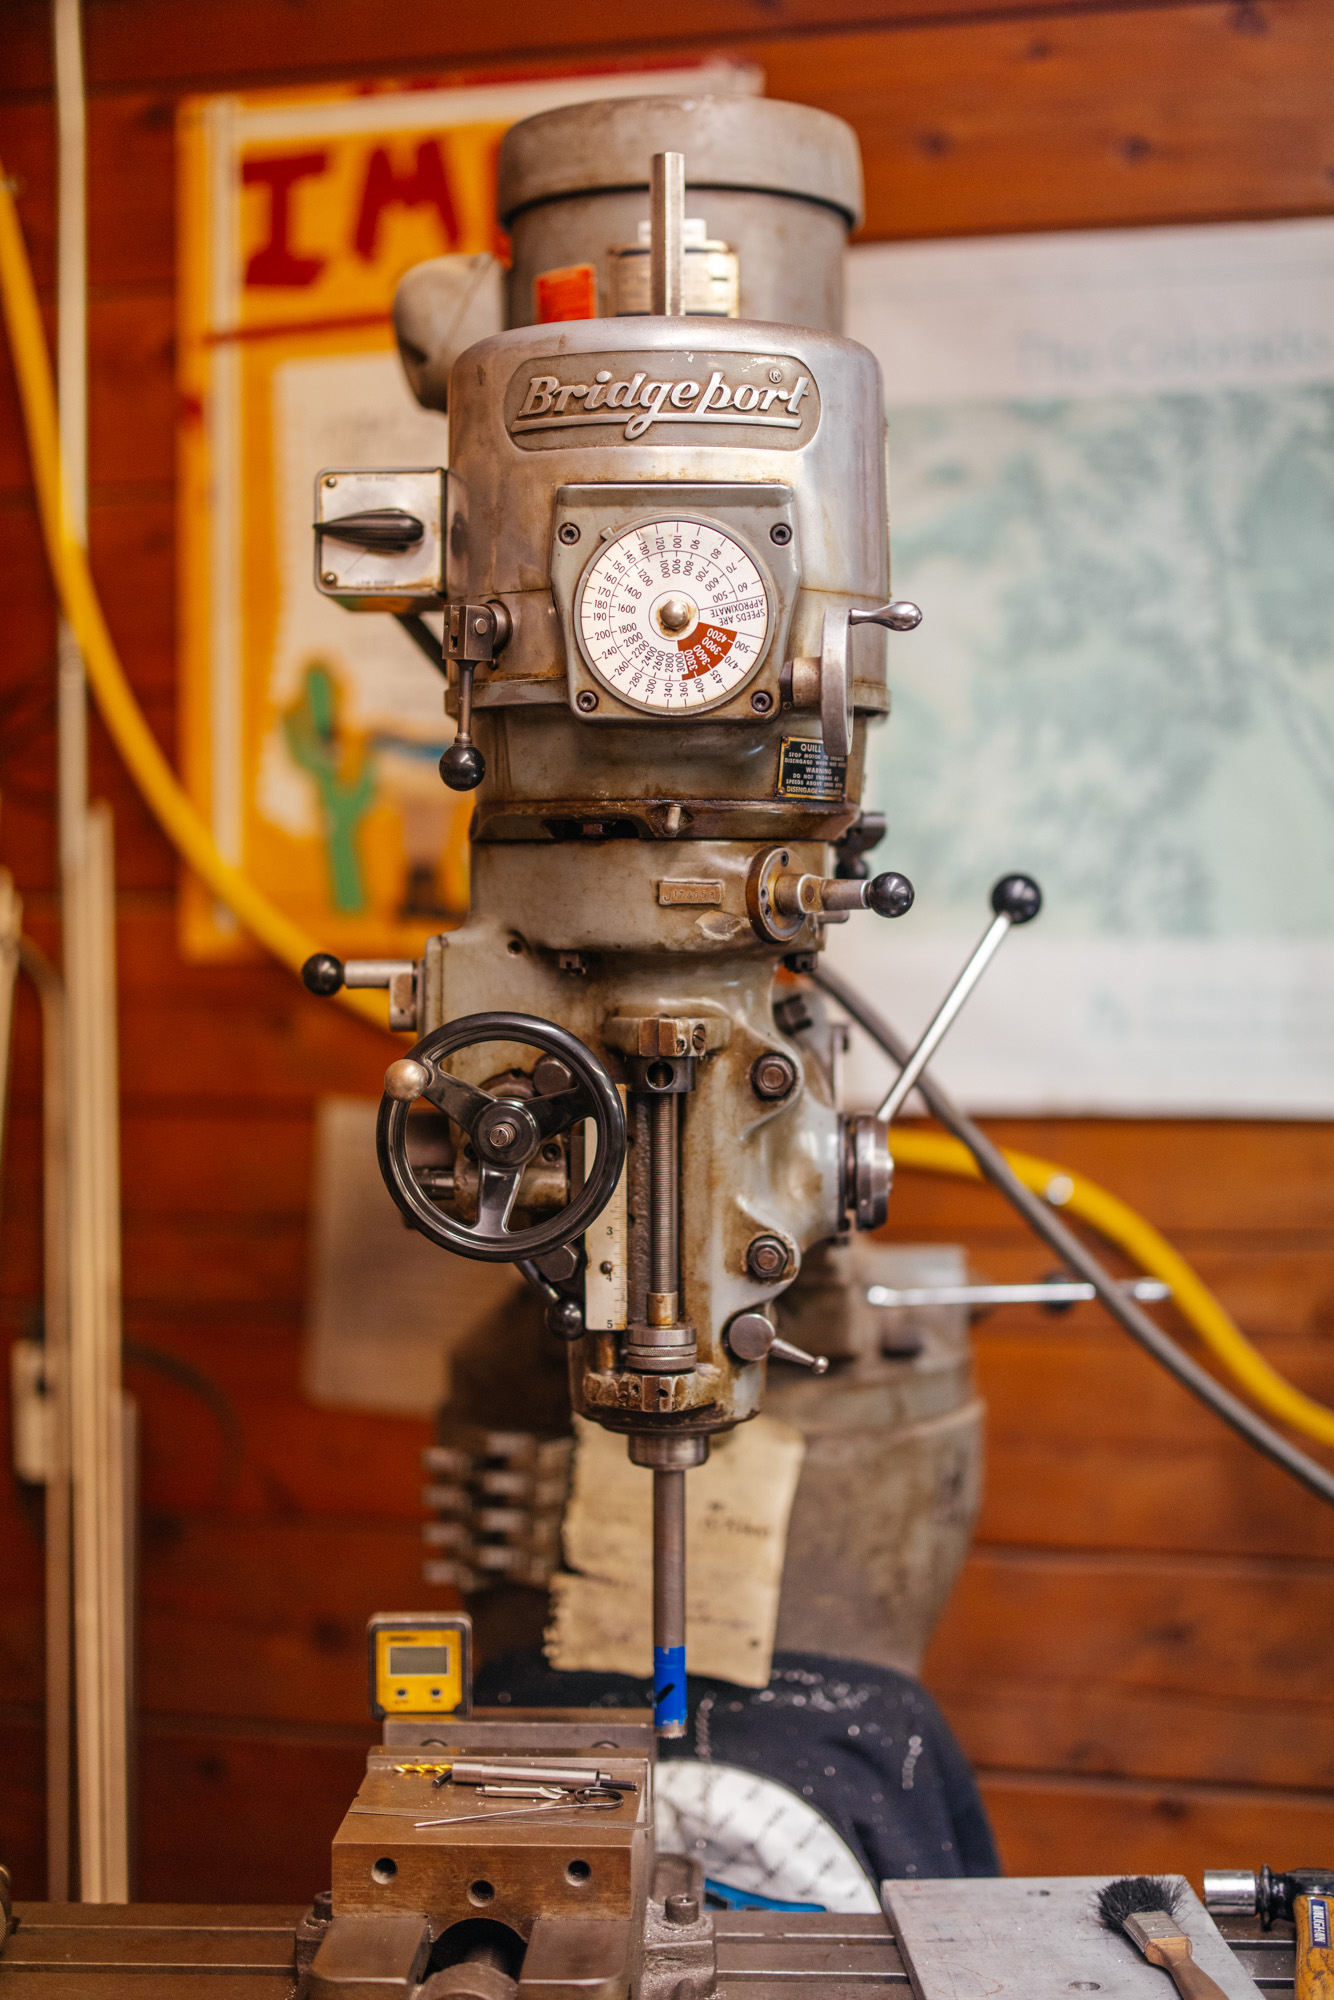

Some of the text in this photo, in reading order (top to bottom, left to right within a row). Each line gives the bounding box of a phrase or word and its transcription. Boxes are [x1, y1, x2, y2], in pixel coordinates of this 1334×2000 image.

[518, 371, 809, 440] Bridgeport
[639, 541, 650, 556] 130
[656, 537, 665, 550] 120
[673, 536, 682, 548] 100
[690, 540, 700, 550] 90
[623, 550, 636, 564] 140
[711, 548, 721, 559] 80
[612, 560, 625, 573] 150
[660, 560, 670, 578] 1000
[672, 559, 680, 574] 900
[683, 561, 694, 576] 800
[696, 566, 709, 582] 700
[726, 562, 737, 573] 70
[604, 572, 617, 584] 160
[638, 568, 653, 586] 1200
[705, 577, 719, 591] 600
[598, 586, 611, 597] 170
[624, 584, 642, 599] 1400
[738, 583, 748, 592] 60
[594, 600, 607, 609] 180
[713, 591, 728, 603] 500
[618, 604, 636, 614] 1600
[710, 598, 764, 618] APPROXIMATE
[720, 609, 765, 626] SPEEDS ARE
[595, 630, 610, 640] 200
[618, 622, 637, 634] 1800
[707, 628, 727, 643] 4200
[624, 632, 643, 647] 2000
[702, 637, 721, 655] 3900
[735, 641, 750, 653] 500
[602, 646, 617, 659] 240
[632, 640, 649, 658] 2200
[642, 646, 657, 666] 2400
[693, 645, 710, 665] 3600
[653, 651, 665, 671] 2600
[665, 653, 674, 673] 2800
[675, 653, 685, 672] 3000
[685, 650, 698, 670] 3300
[724, 656, 739, 669] 470
[615, 661, 629, 676] 260
[629, 672, 643, 687] 280
[710, 670, 722, 684] 435
[645, 679, 656, 694] 300
[664, 682, 673, 698] 340
[679, 682, 688, 697] 360
[694, 678, 704, 693] 400
[801, 744, 821, 753] QUILL
[806, 767, 832, 775] WARNING
[787, 786, 817, 794] DISENGAGE
[606, 1226, 613, 1235] 3
[607, 1320, 613, 1328] 5
